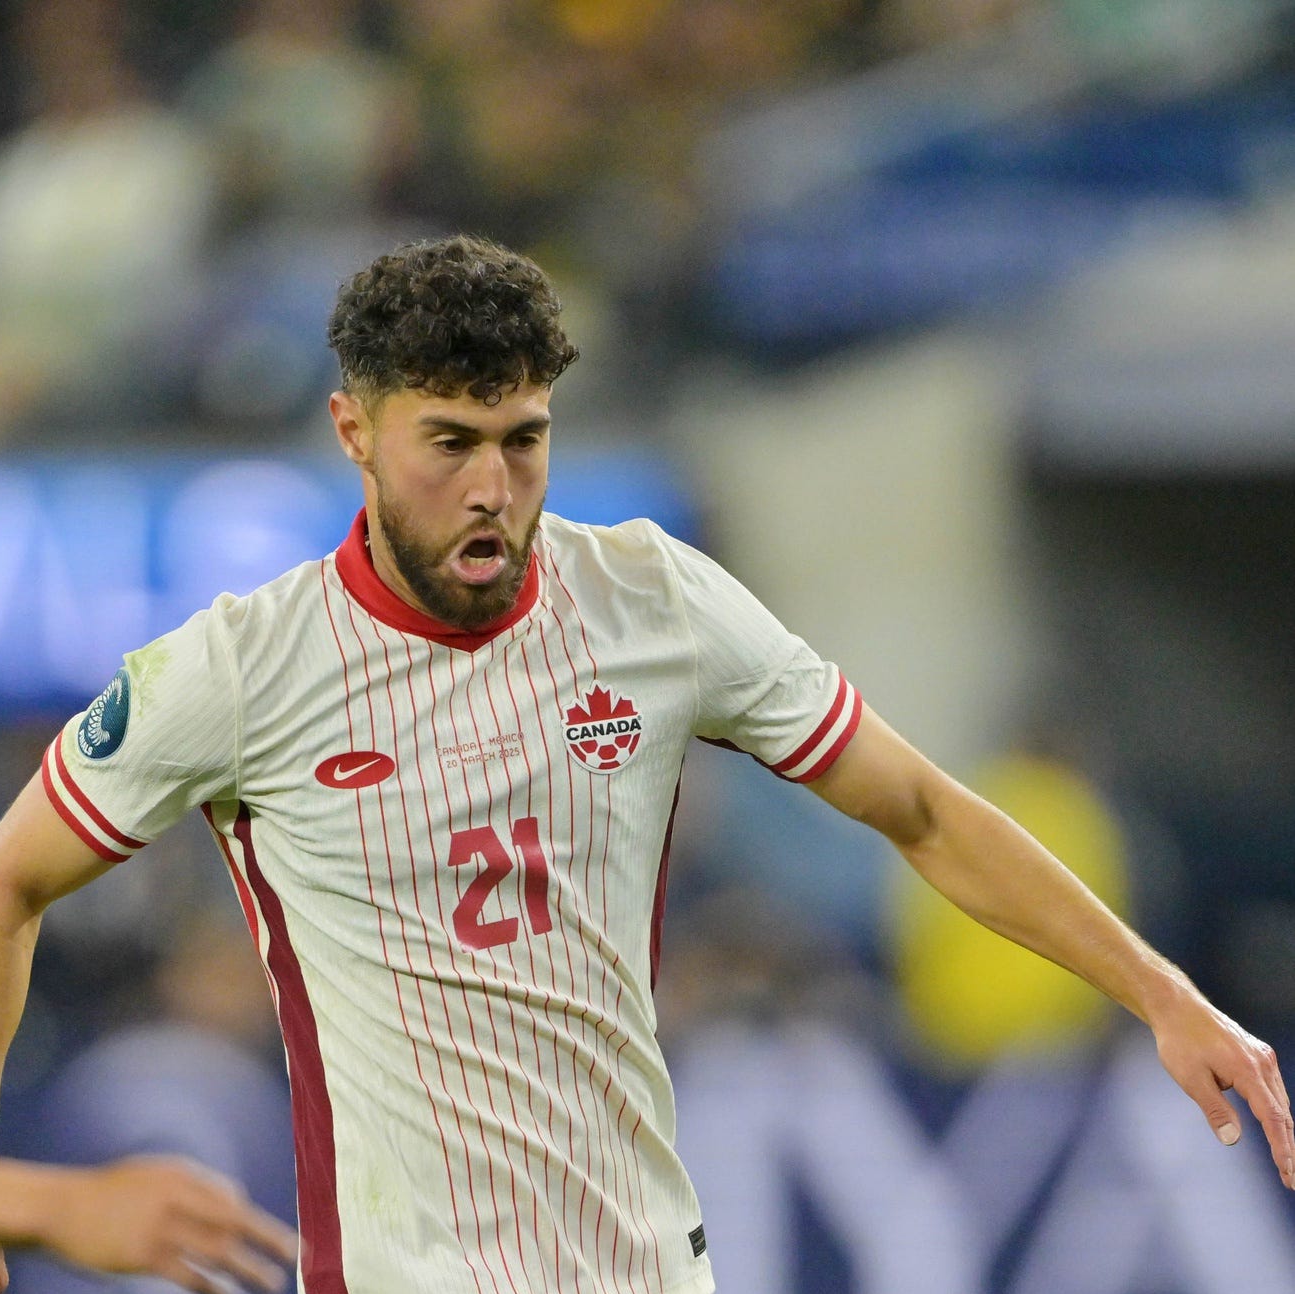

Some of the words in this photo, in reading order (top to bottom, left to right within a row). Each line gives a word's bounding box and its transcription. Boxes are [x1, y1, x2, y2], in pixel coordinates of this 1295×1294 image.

[566, 718, 642, 741] CANADA
[436, 742, 477, 757] CANADA
[446, 759, 458, 769] 20
[461, 751, 496, 766] MARCH
[498, 747, 521, 760] 2025
[447, 817, 553, 954] 21
